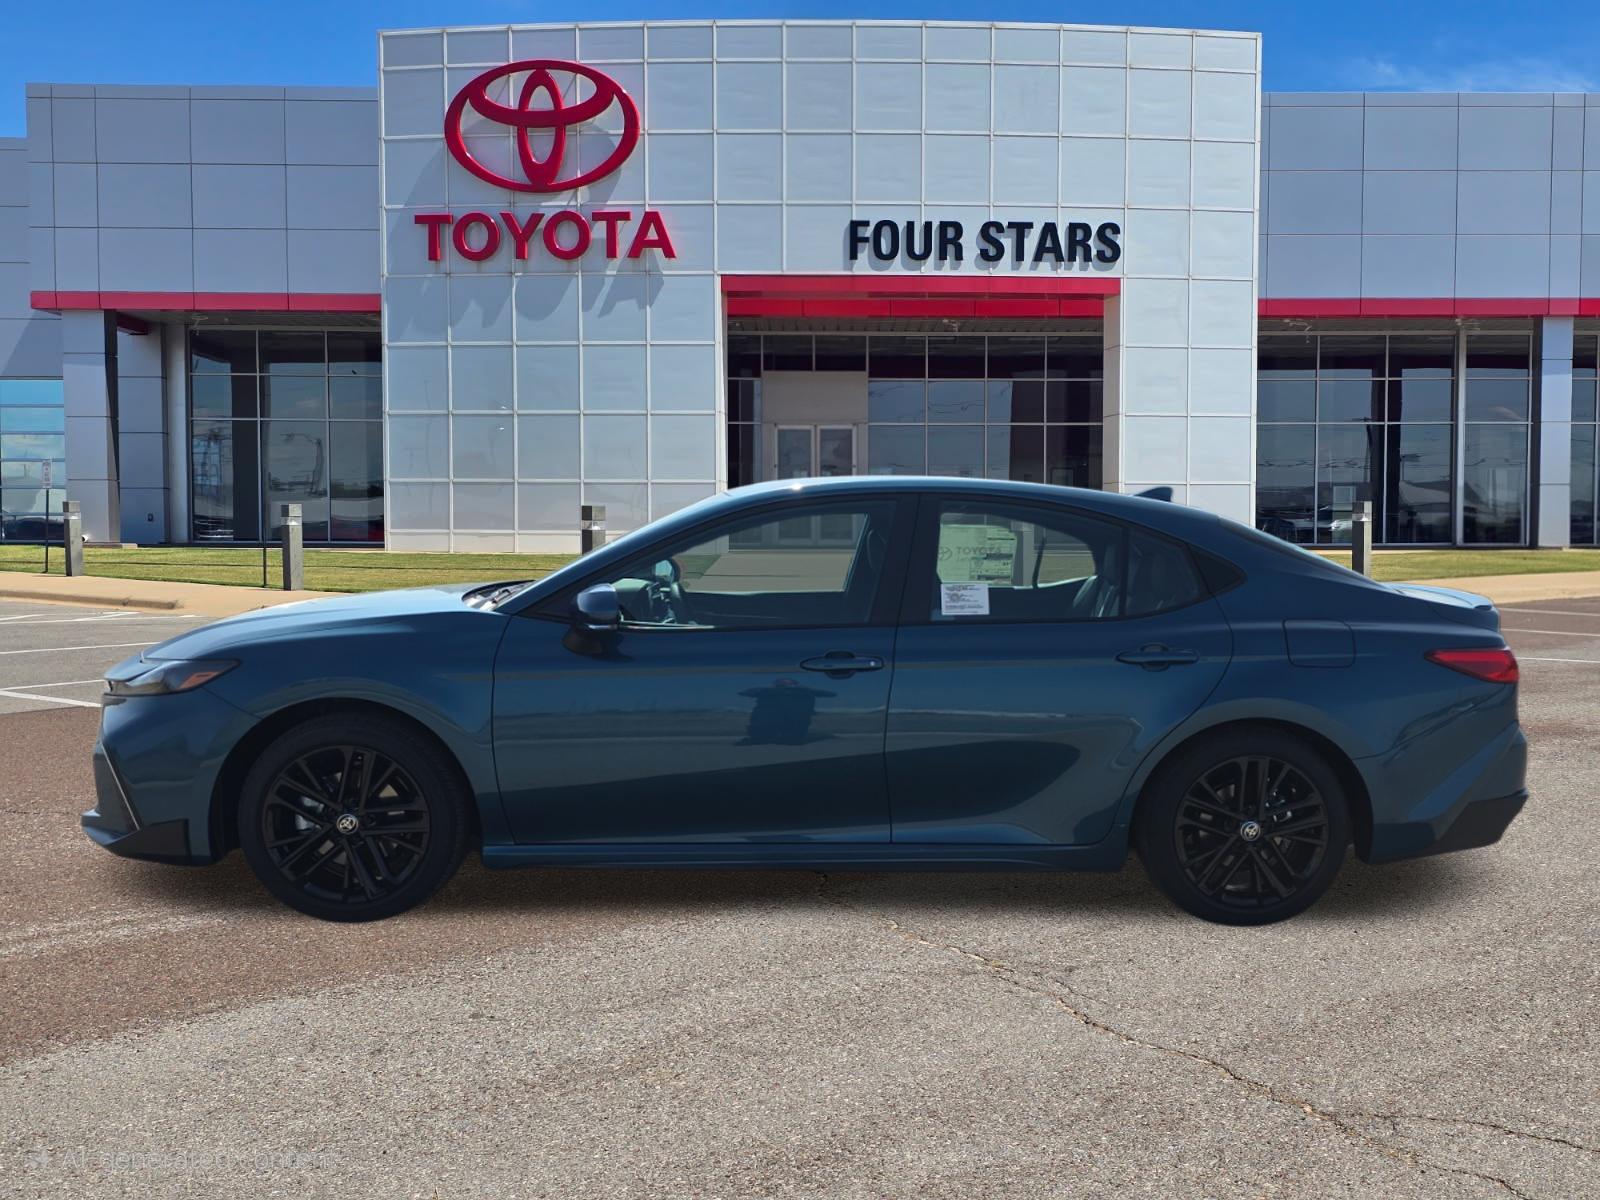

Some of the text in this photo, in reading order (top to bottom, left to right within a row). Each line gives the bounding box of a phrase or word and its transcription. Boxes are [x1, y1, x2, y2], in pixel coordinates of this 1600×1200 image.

[415, 211, 676, 260] TOYOTA
[849, 219, 1121, 264] FOUR STARS
[956, 546, 1002, 556] TOYOTA
